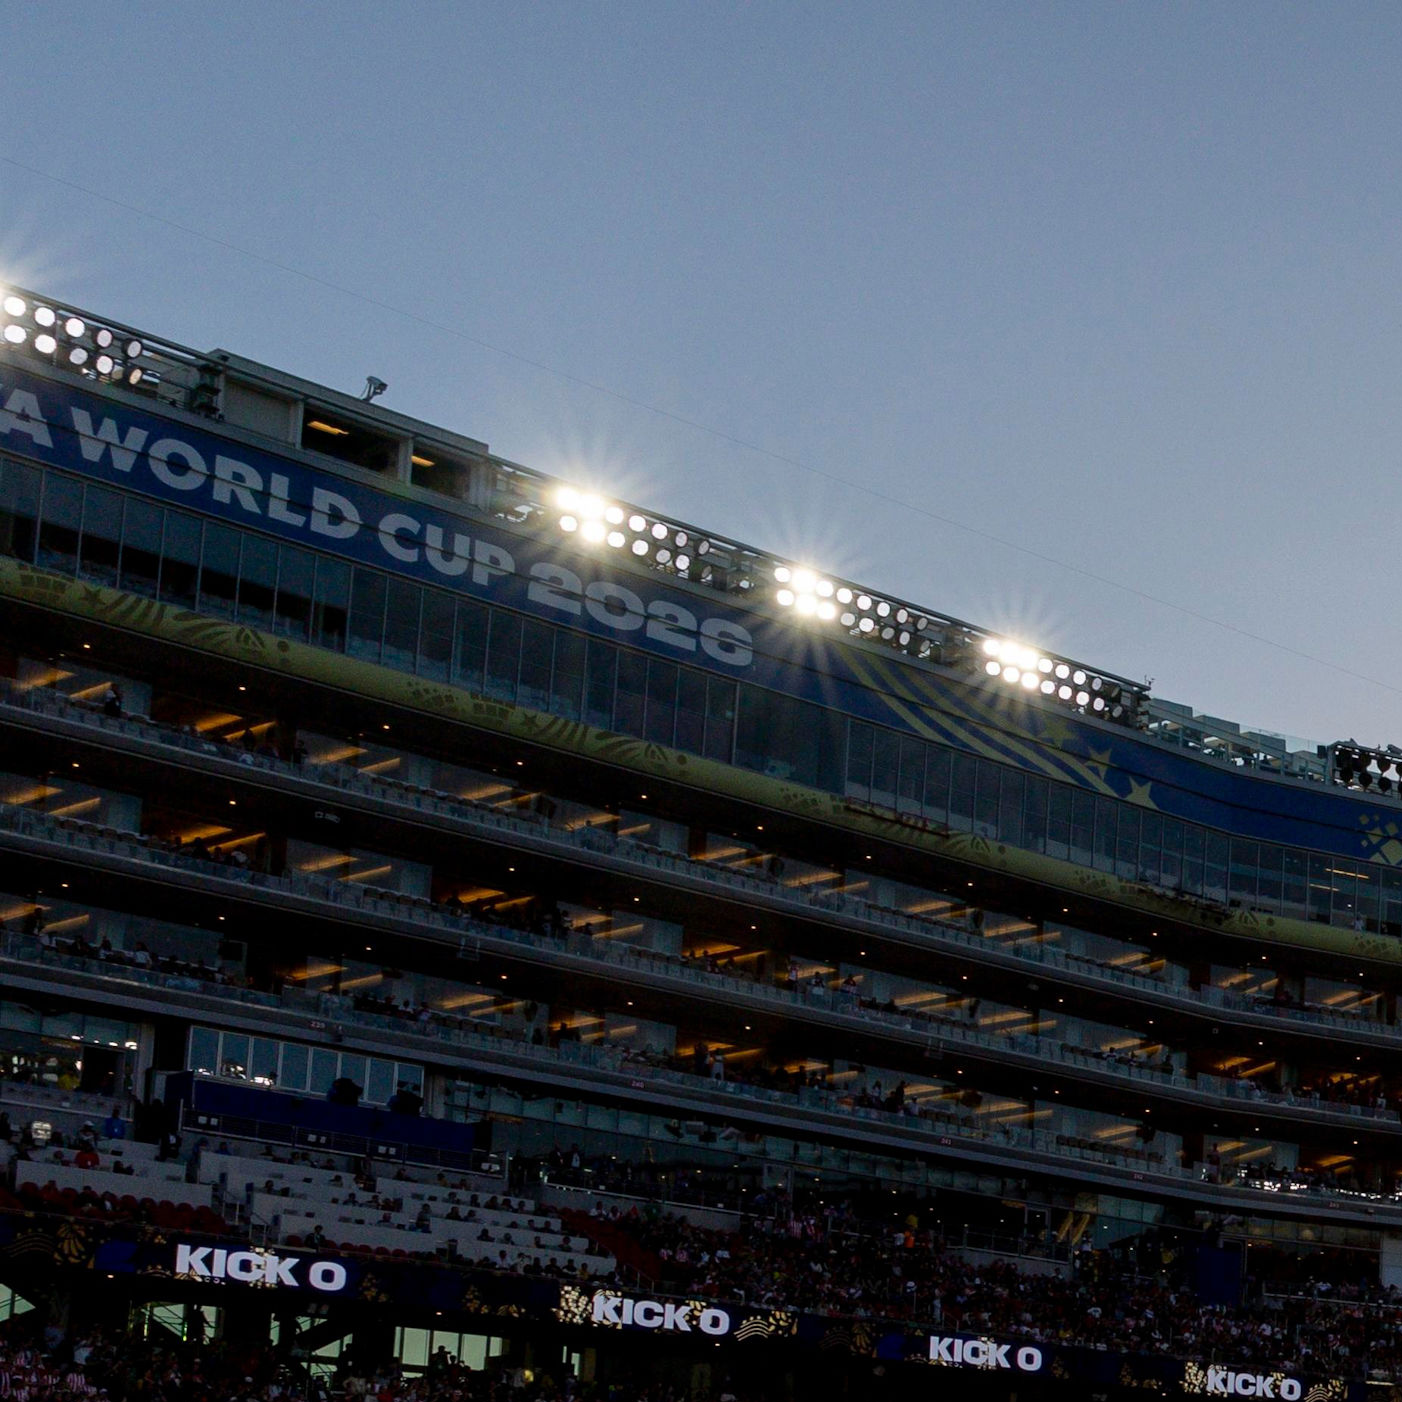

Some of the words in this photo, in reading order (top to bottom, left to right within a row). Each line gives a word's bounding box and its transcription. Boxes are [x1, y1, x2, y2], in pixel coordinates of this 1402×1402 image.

[71, 407, 361, 539] WORLD
[378, 513, 515, 586] CUP
[528, 562, 753, 667] 2026
[175, 1243, 301, 1287] KICK
[308, 1260, 347, 1291] O
[592, 1293, 693, 1333] KICK
[699, 1307, 730, 1336] O
[929, 1335, 1012, 1369] KICK
[1016, 1346, 1043, 1371] O
[1206, 1369, 1276, 1399] KICK
[1279, 1378, 1301, 1401] O
